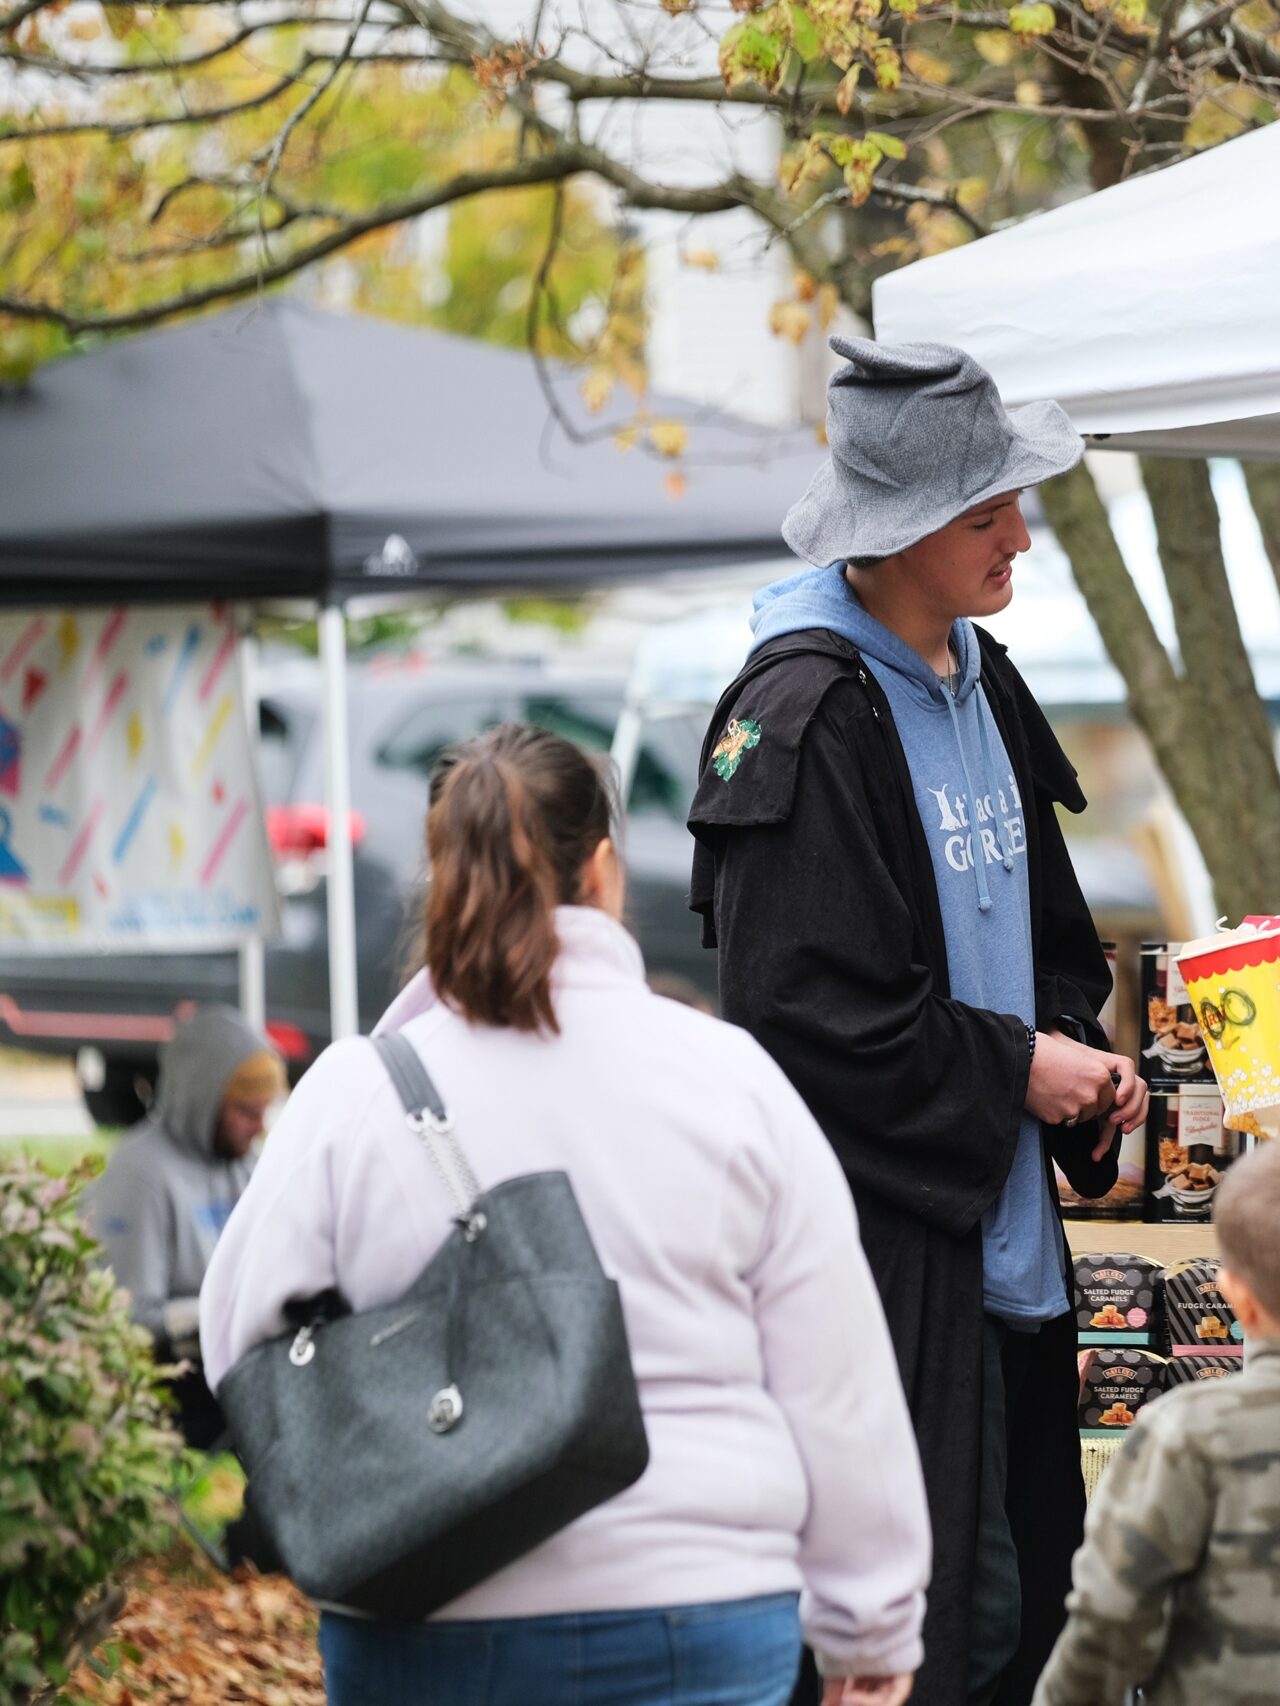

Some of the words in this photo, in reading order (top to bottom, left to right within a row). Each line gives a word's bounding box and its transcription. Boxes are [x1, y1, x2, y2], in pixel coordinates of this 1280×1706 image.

[1092, 1269, 1125, 1281] BAILEYS
[1103, 1367, 1135, 1379] BAILEYS
[1093, 1386, 1119, 1394] SALTED
[1120, 1386, 1144, 1394] FUDGE
